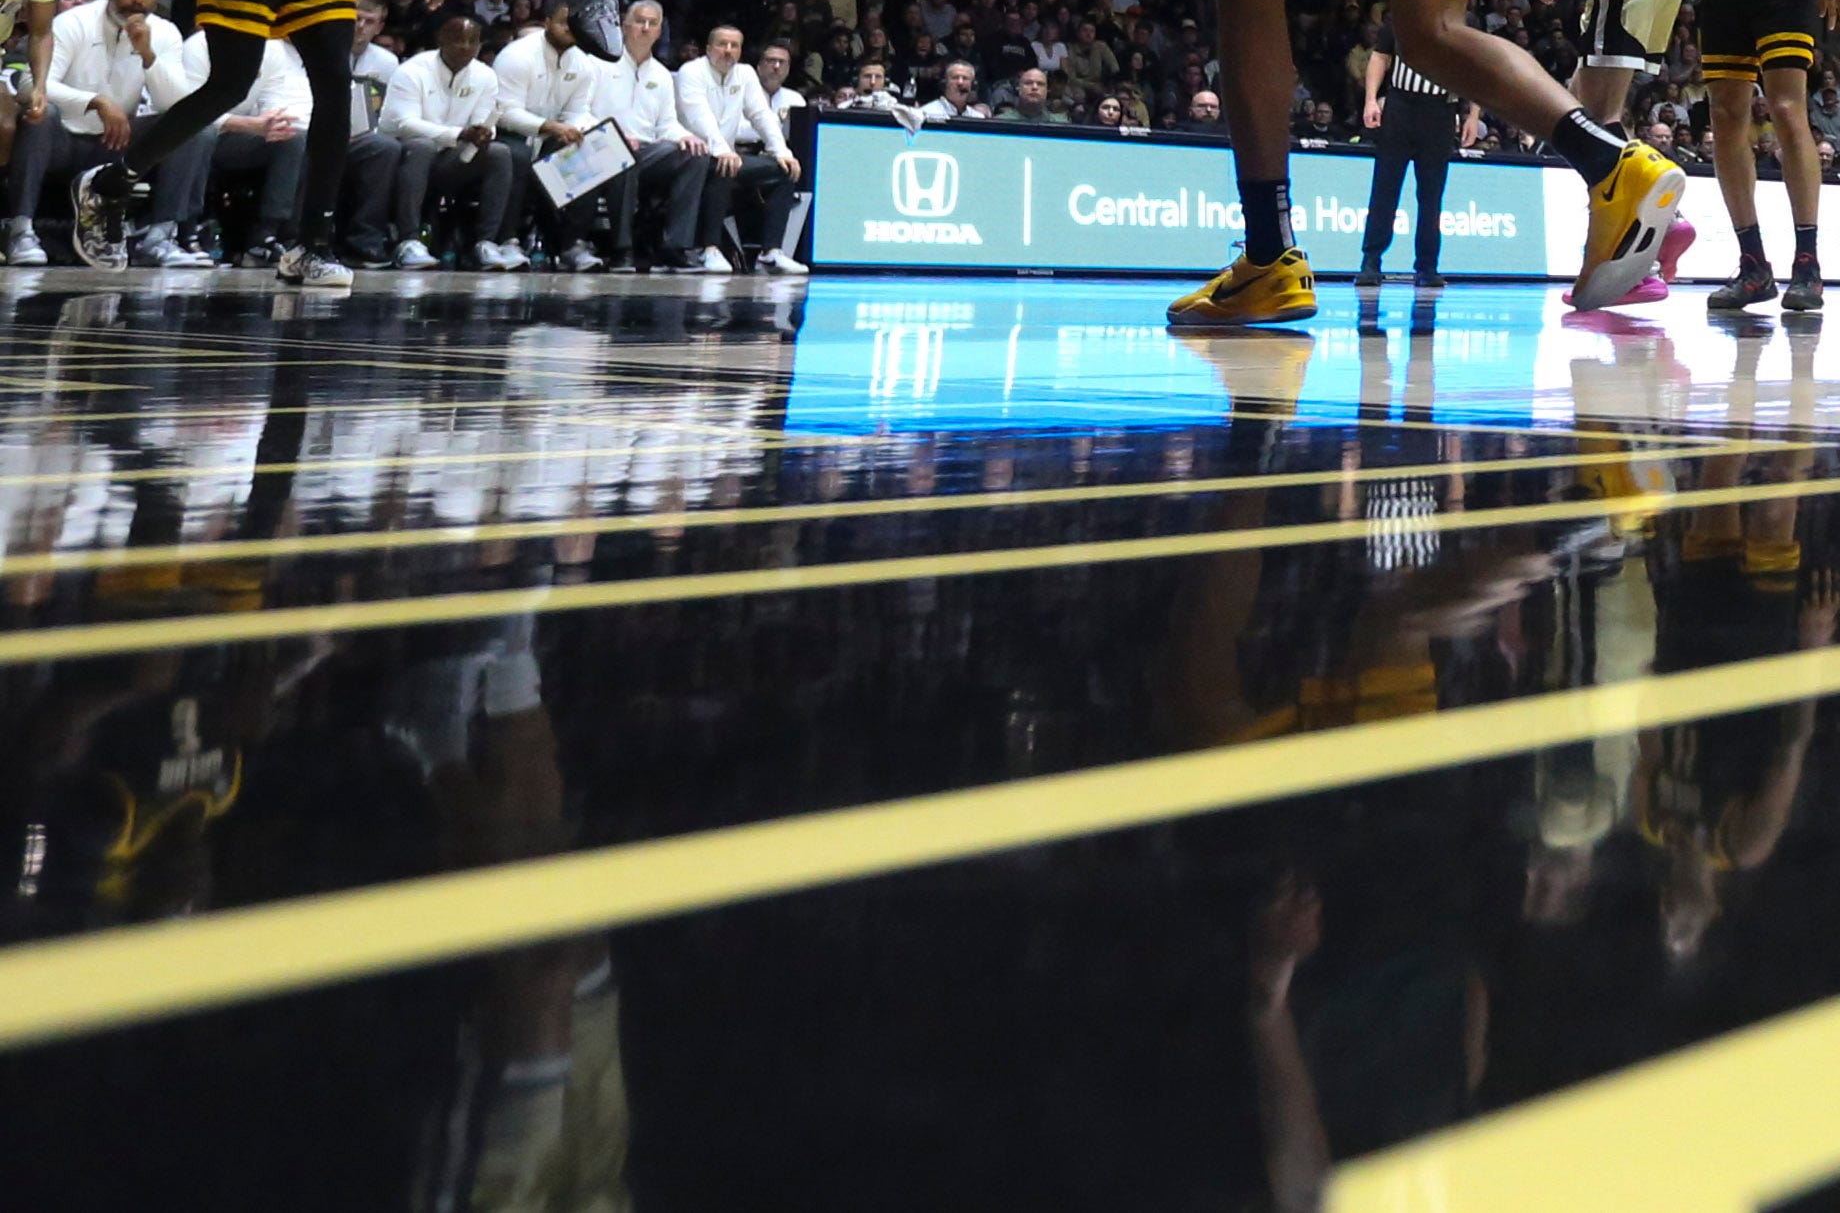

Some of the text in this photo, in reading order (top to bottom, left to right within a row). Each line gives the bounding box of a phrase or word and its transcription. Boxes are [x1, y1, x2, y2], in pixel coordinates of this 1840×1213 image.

[1068, 184, 1188, 228] Central
[1439, 199, 1517, 238] ealers
[864, 220, 983, 244] HONDA
